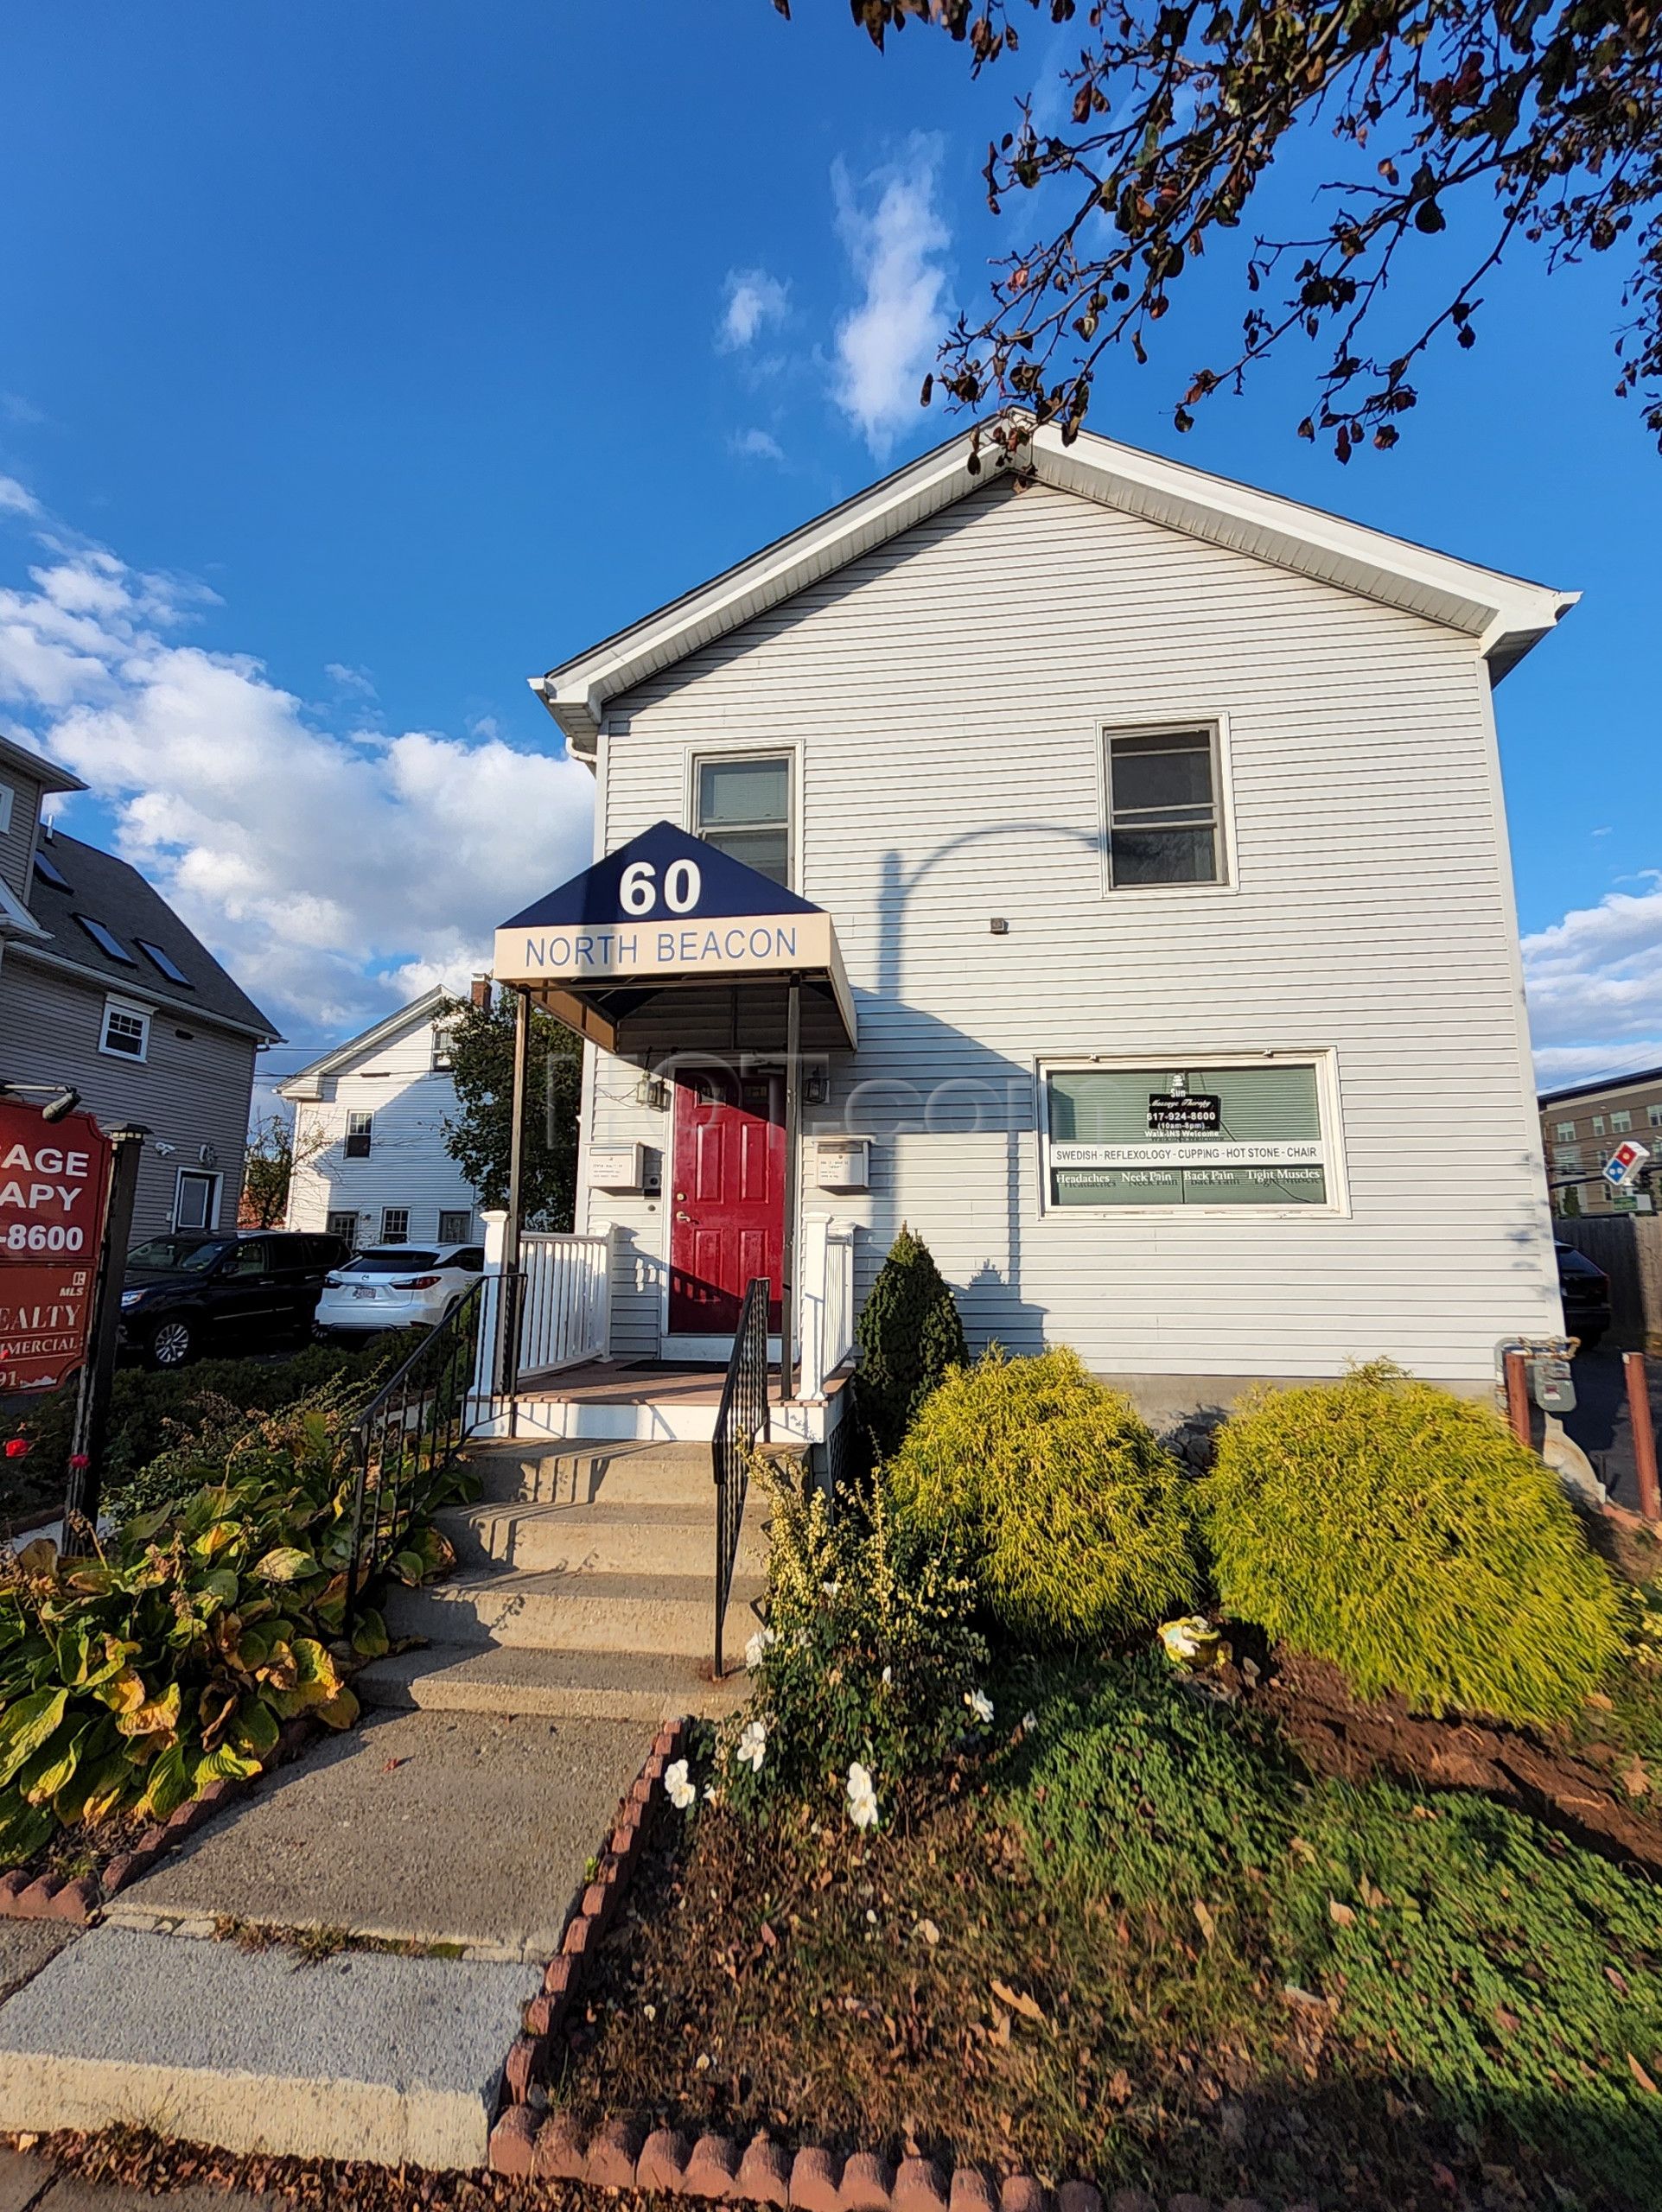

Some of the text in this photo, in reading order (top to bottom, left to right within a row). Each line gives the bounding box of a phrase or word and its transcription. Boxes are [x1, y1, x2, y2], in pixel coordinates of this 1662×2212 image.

[619, 859, 702, 916] 60
[525, 927, 797, 967] NORTH BEACON
[1170, 1088, 1187, 1097] Sun
[1146, 1112, 1216, 1121] 617-924-8600
[0, 1144, 89, 1177] AGE
[1056, 1150, 1098, 1160] SWEDISH
[1104, 1149, 1171, 1160] REFLEXOLOGY
[1178, 1148, 1219, 1159] CUPPING
[1226, 1148, 1245, 1158] HOT
[1248, 1147, 1280, 1158] STONE
[1287, 1147, 1317, 1157] CHAIR
[1056, 1168, 1321, 1184] Headaches Neck Pain Back Pain Tight Muscles
[0, 1181, 82, 1211] APY
[59, 1287, 84, 1297] MLS
[0, 1337, 78, 1356] MERCIAL
